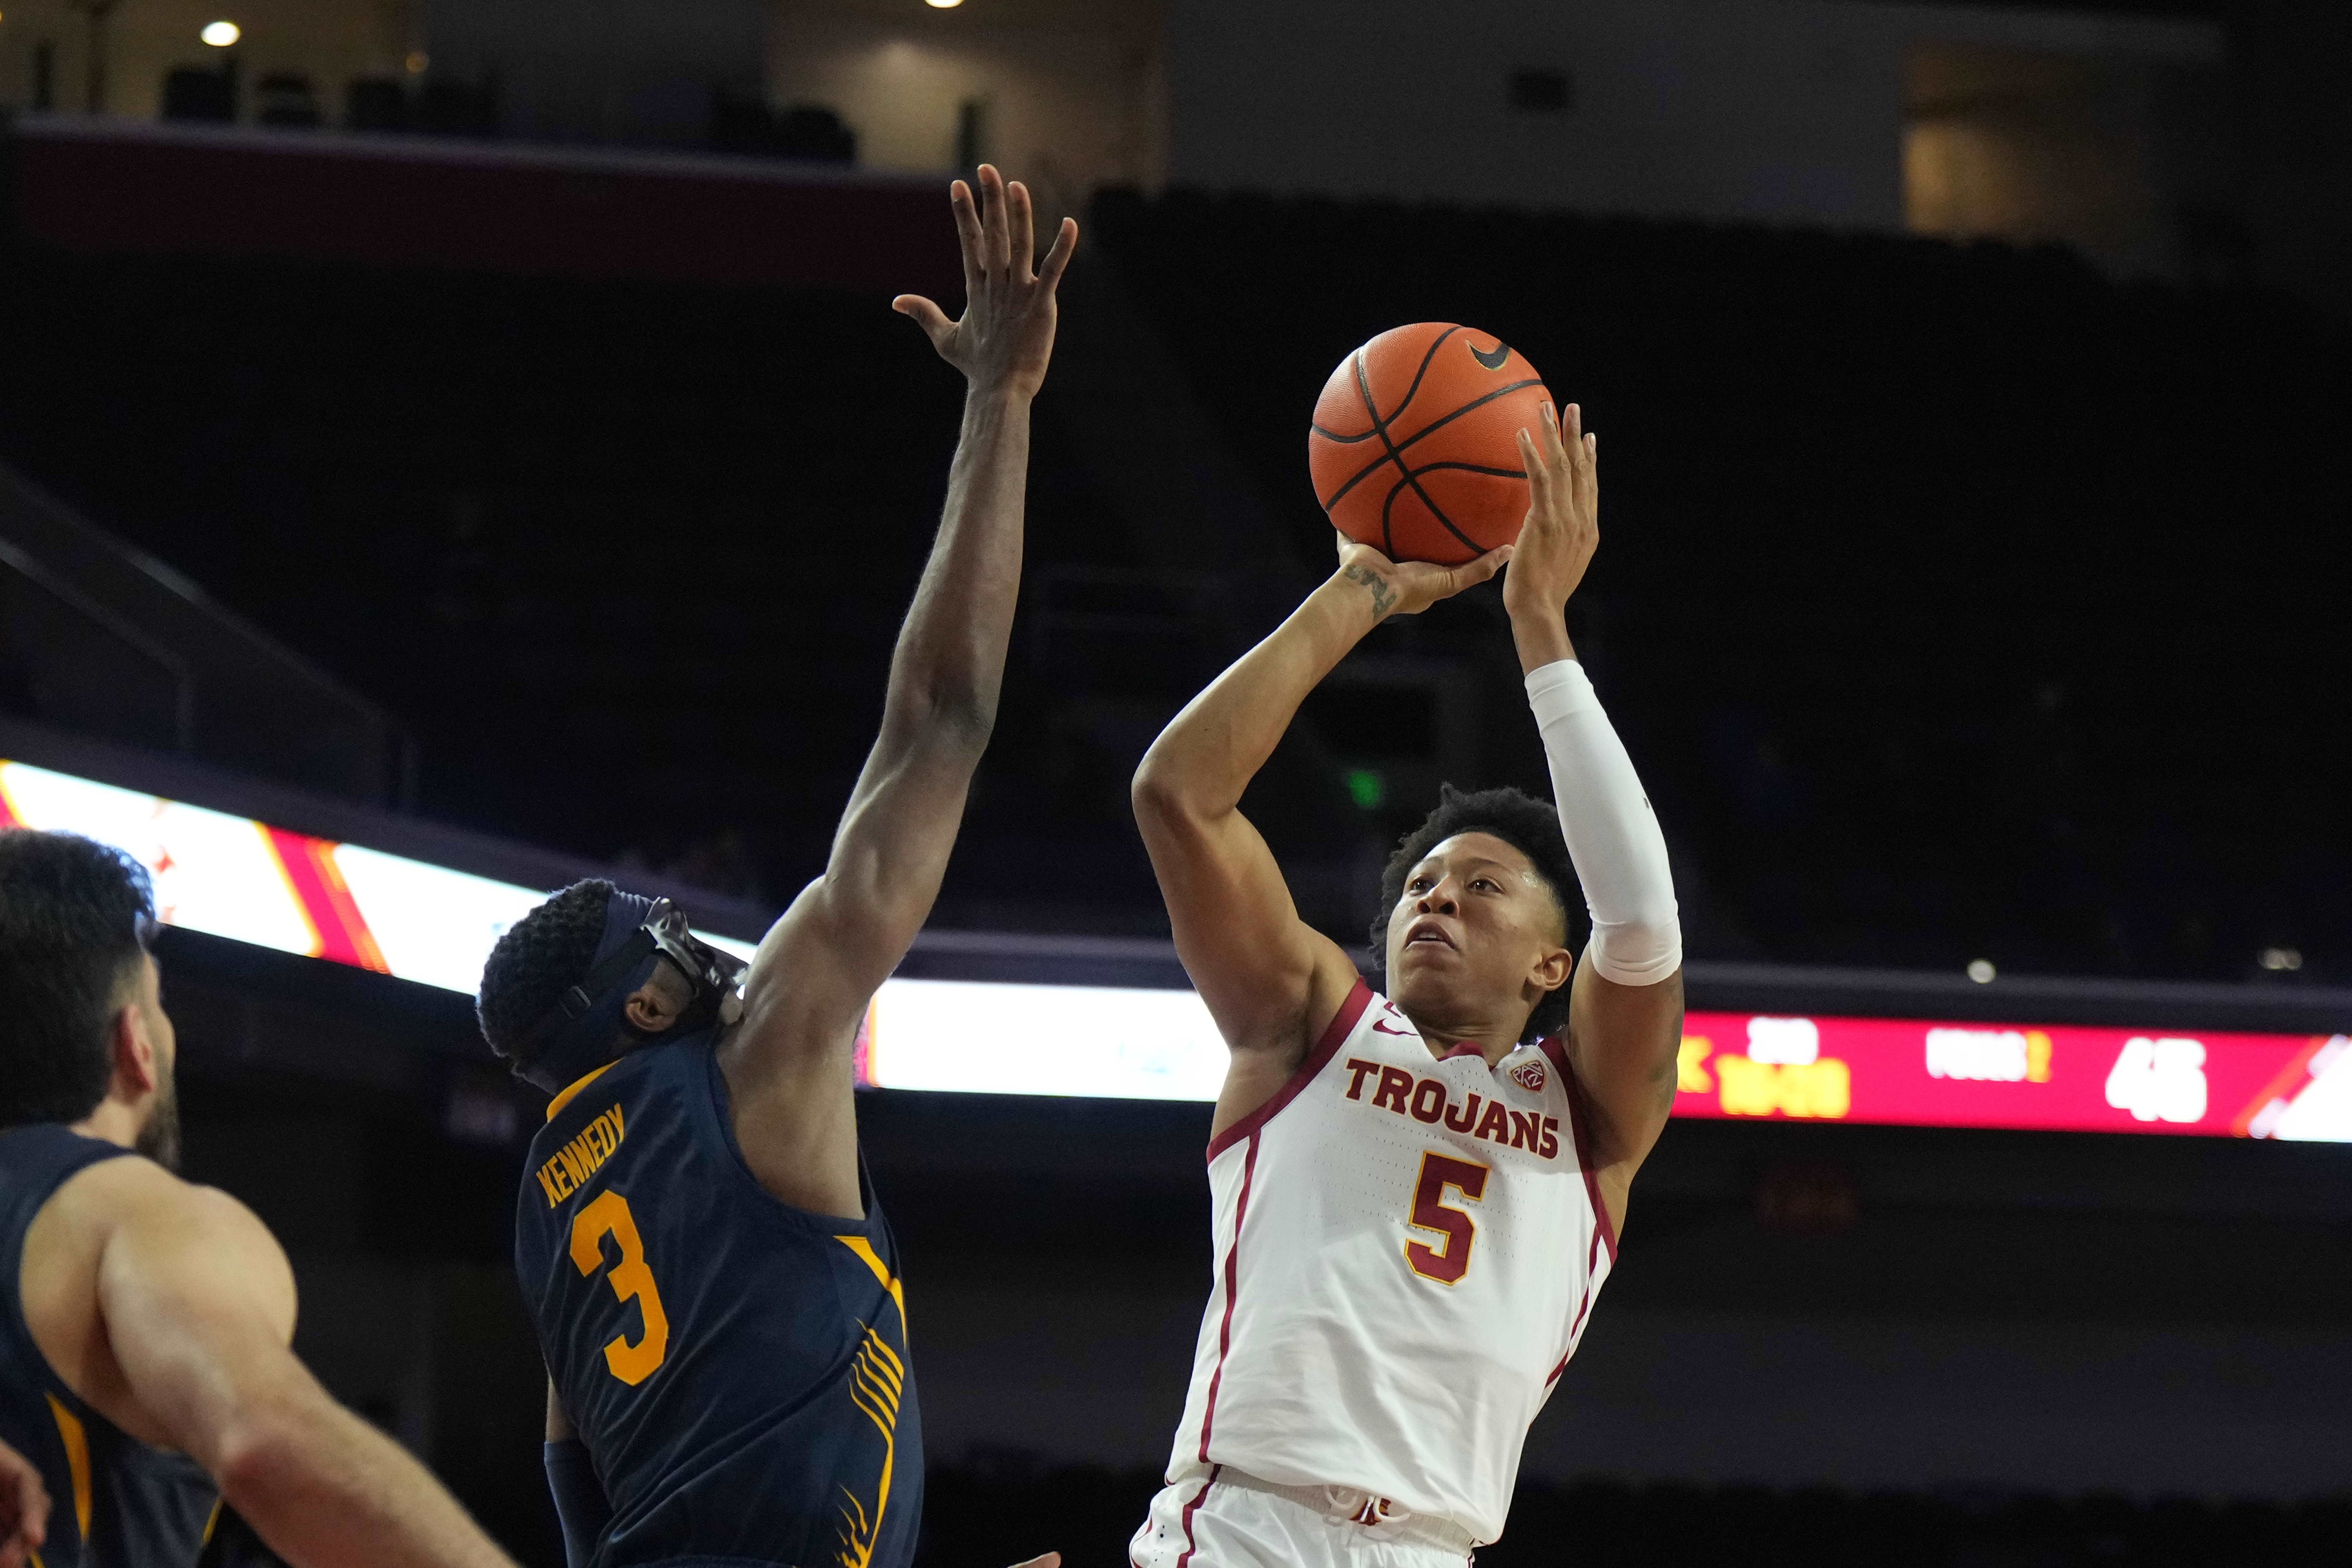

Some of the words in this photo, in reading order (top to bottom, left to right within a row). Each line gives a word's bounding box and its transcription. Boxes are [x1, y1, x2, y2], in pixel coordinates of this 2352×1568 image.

[1345, 1058, 1559, 1160] TROJANS
[1512, 1061, 1544, 1085] PAC
[1524, 1073, 1542, 1088] 12
[536, 1103, 624, 1209] KENNEDY
[1404, 1150, 1490, 1286] 5
[569, 1189, 669, 1386] 3
